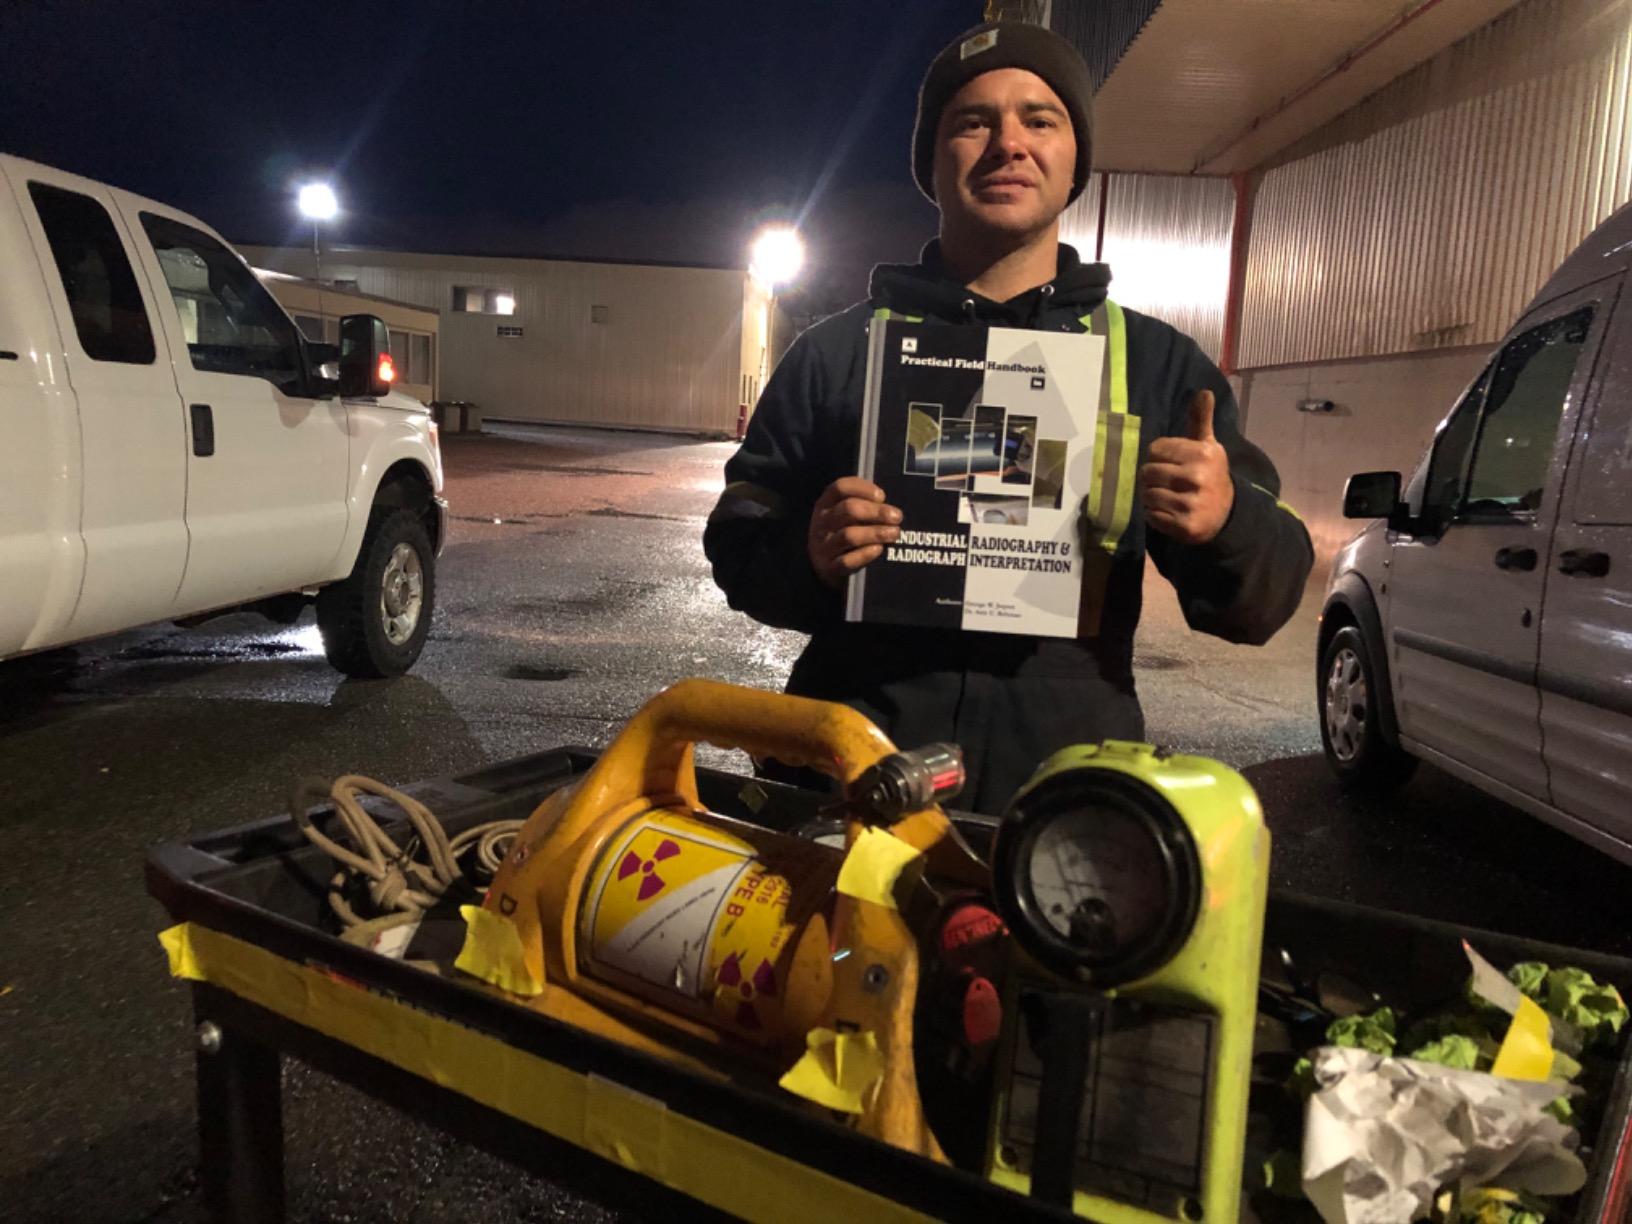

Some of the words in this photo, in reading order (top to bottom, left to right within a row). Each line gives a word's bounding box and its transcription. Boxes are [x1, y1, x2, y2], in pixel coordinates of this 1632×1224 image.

[900, 354, 953, 368] Practical
[955, 358, 985, 371] Field
[987, 360, 1046, 374] Handbook
[971, 535, 1058, 555] RADIOGRAPHY
[1060, 541, 1071, 556] &
[887, 547, 966, 566] RADIOGRAPH
[969, 553, 1072, 573] INTERPRETATION
[727, 902, 745, 918] B
